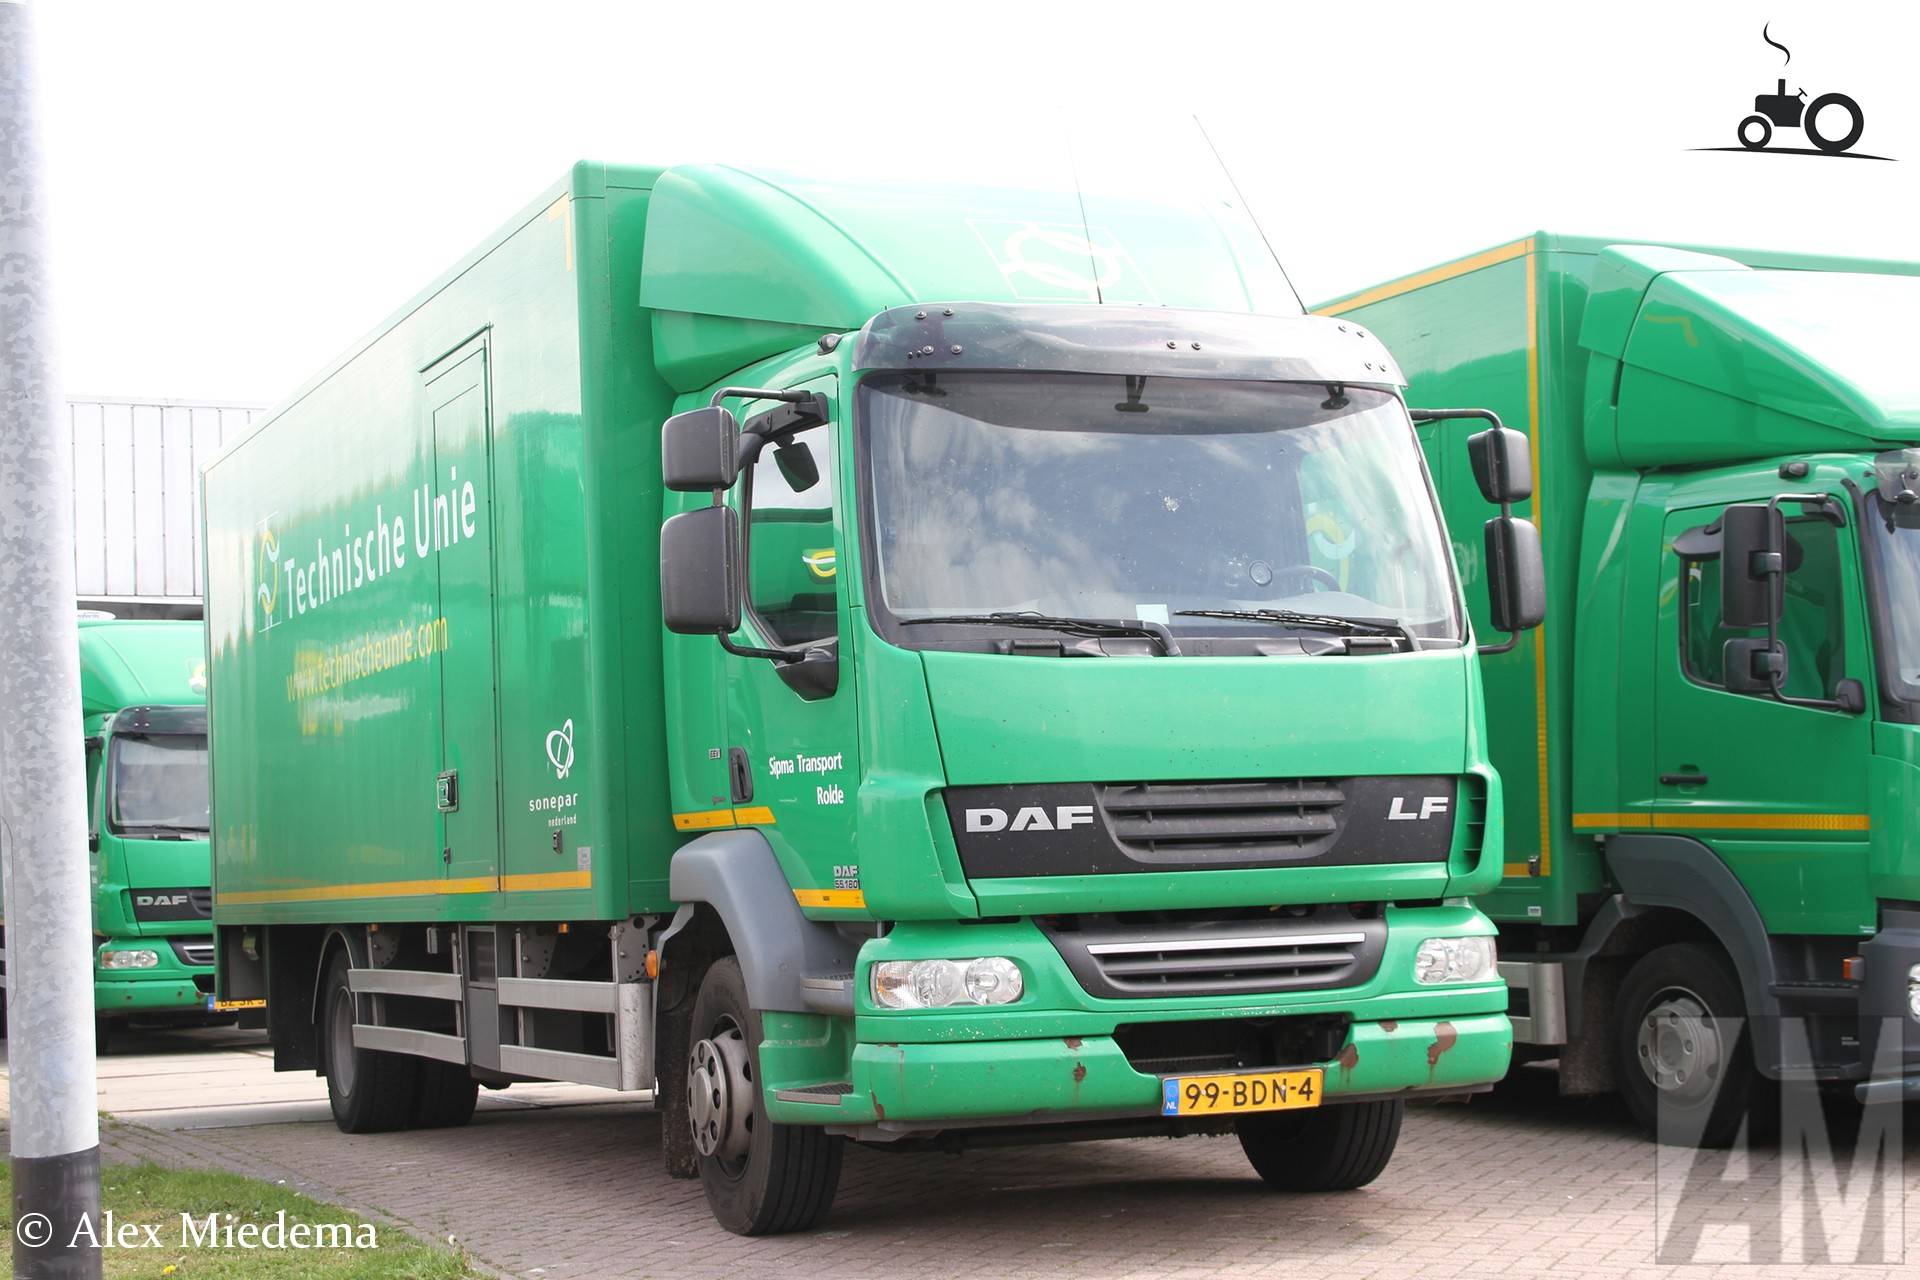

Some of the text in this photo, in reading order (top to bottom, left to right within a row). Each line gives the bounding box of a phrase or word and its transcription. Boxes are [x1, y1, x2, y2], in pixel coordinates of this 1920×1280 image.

[284, 466, 476, 618] Technische Unie
[286, 616, 449, 702] www.technischeunie.com
[768, 752, 843, 779] Sipma Transport
[529, 793, 578, 812] sonepar
[816, 784, 844, 805] Rolde
[965, 805, 1094, 832] DAF
[1388, 796, 1449, 820] LF
[548, 813, 577, 827] nederland
[833, 865, 858, 878] DAF
[136, 895, 188, 906] DAF
[1185, 1077, 1314, 1109] 99-BDN-4
[1166, 1101, 1177, 1110] NL
